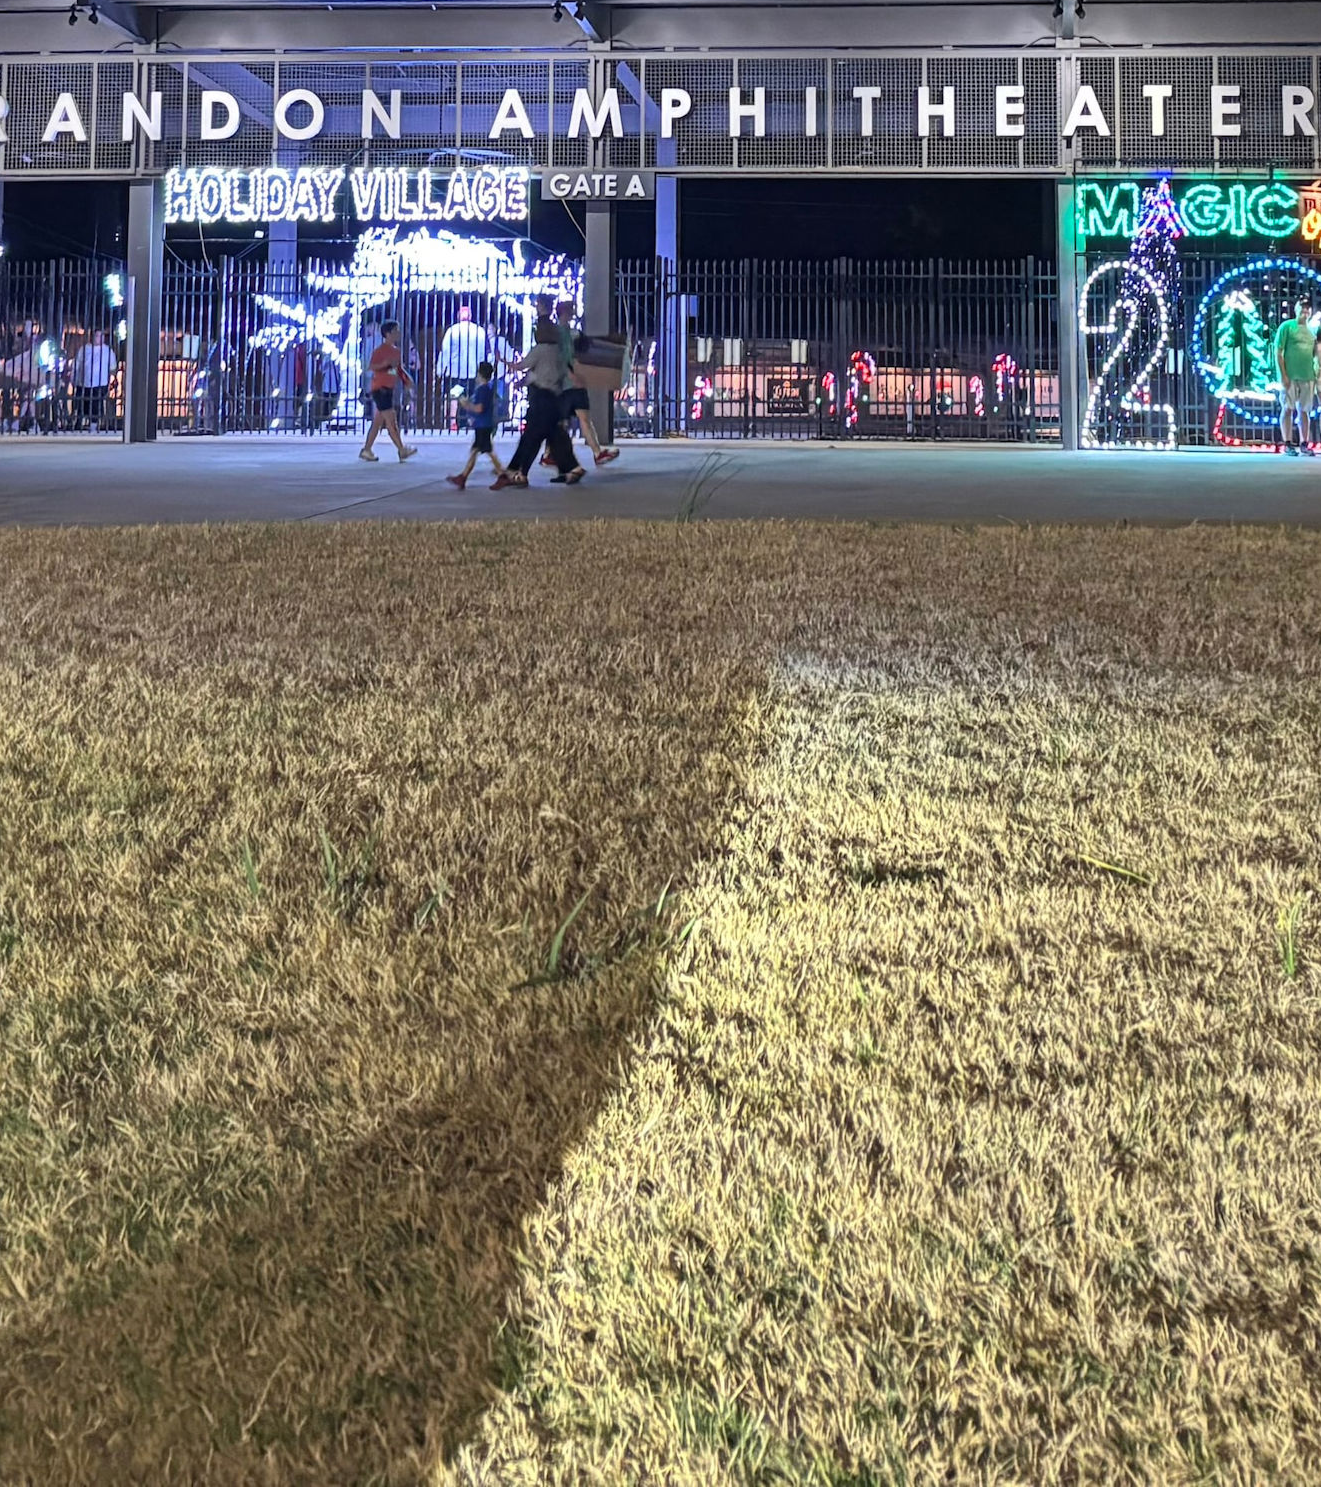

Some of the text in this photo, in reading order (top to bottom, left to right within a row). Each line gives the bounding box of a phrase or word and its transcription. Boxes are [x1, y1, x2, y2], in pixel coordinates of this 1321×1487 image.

[488, 84, 1319, 140] AMPHITHEATER
[164, 165, 529, 224] HOLIDAY VILLAGE
[549, 174, 646, 198] GATE A
[1076, 179, 1302, 239] MAGIC
